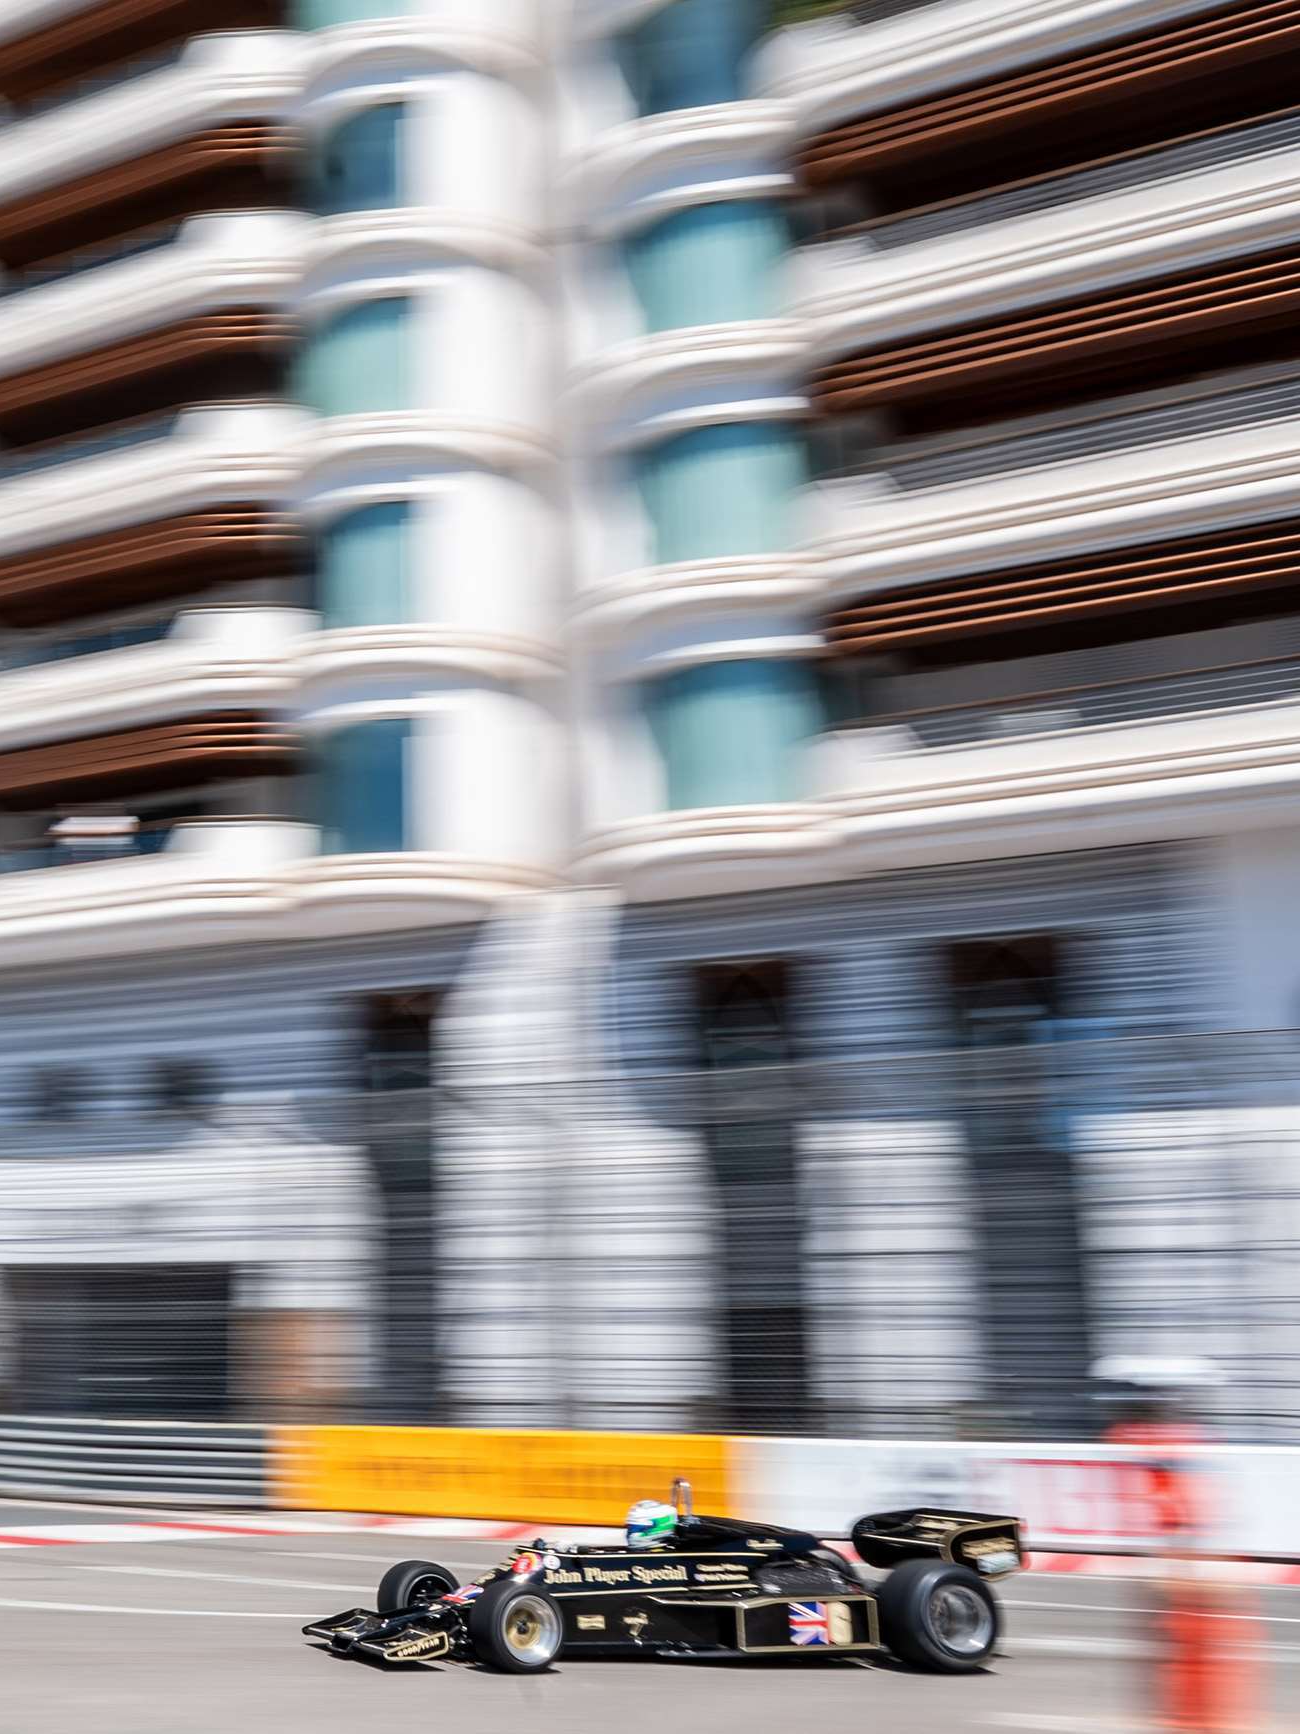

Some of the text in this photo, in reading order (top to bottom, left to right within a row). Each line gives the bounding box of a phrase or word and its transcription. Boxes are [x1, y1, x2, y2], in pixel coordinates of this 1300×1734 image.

[543, 1569, 582, 1584] John
[584, 1567, 631, 1585] Player
[632, 1565, 689, 1584] Special
